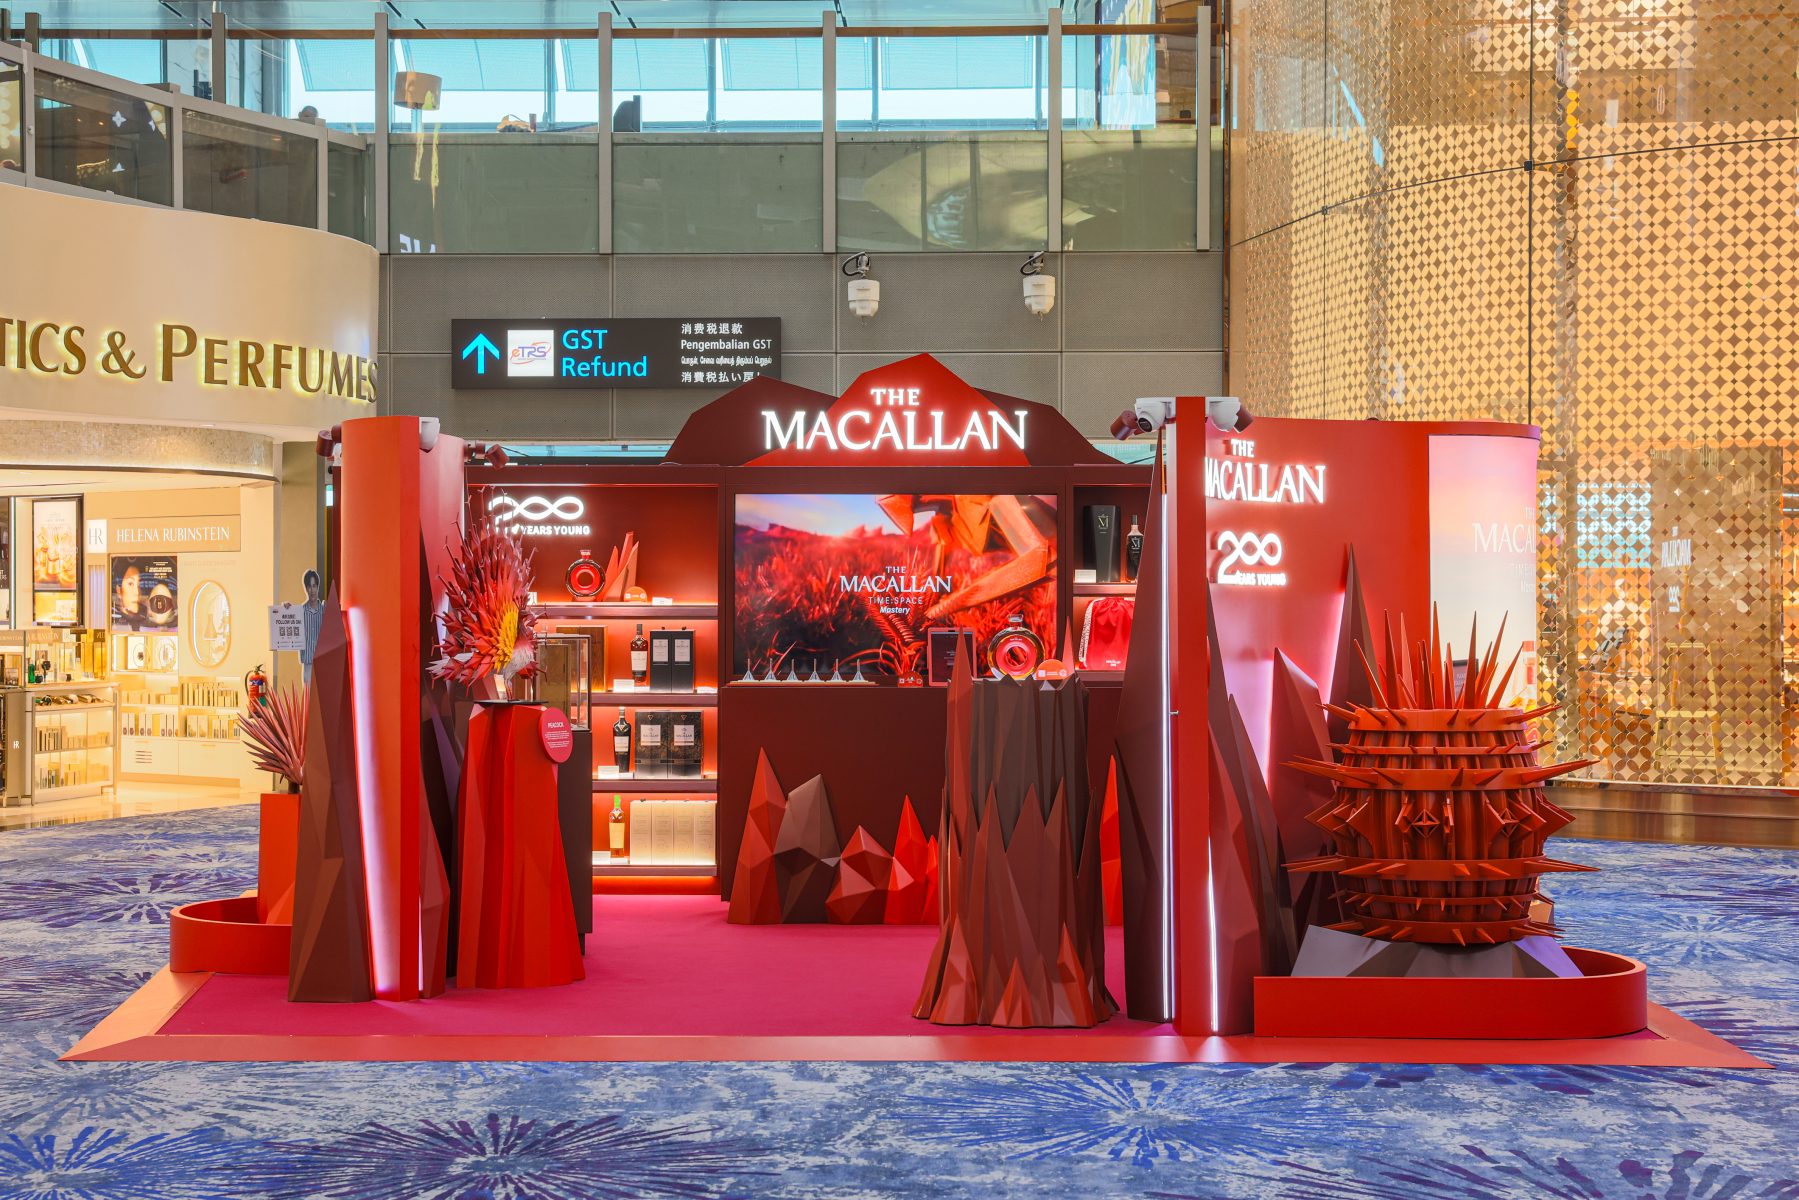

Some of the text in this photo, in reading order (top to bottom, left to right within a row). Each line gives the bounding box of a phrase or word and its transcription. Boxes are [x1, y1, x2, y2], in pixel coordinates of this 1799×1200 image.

[681, 322, 743, 335] 消费税退款
[561, 329, 608, 351] GST
[680, 338, 773, 352] Pengembalian GST
[101, 330, 147, 380] &
[160, 322, 379, 404] PERFUMES
[562, 355, 648, 378] Refund
[681, 371, 760, 384] 消費税払い戻
[870, 388, 921, 406] THE
[760, 409, 1029, 451] MACALLAN
[1230, 438, 1256, 458] THE
[116, 526, 231, 543] HELENA RUBINSTEIN
[554, 524, 591, 536] YOUNG
[1217, 530, 1283, 585] 200
[885, 565, 907, 574] THE
[839, 574, 953, 593] MACALLAN
[867, 596, 924, 605] TIME:SPACE
[879, 605, 911, 615] Mastery
